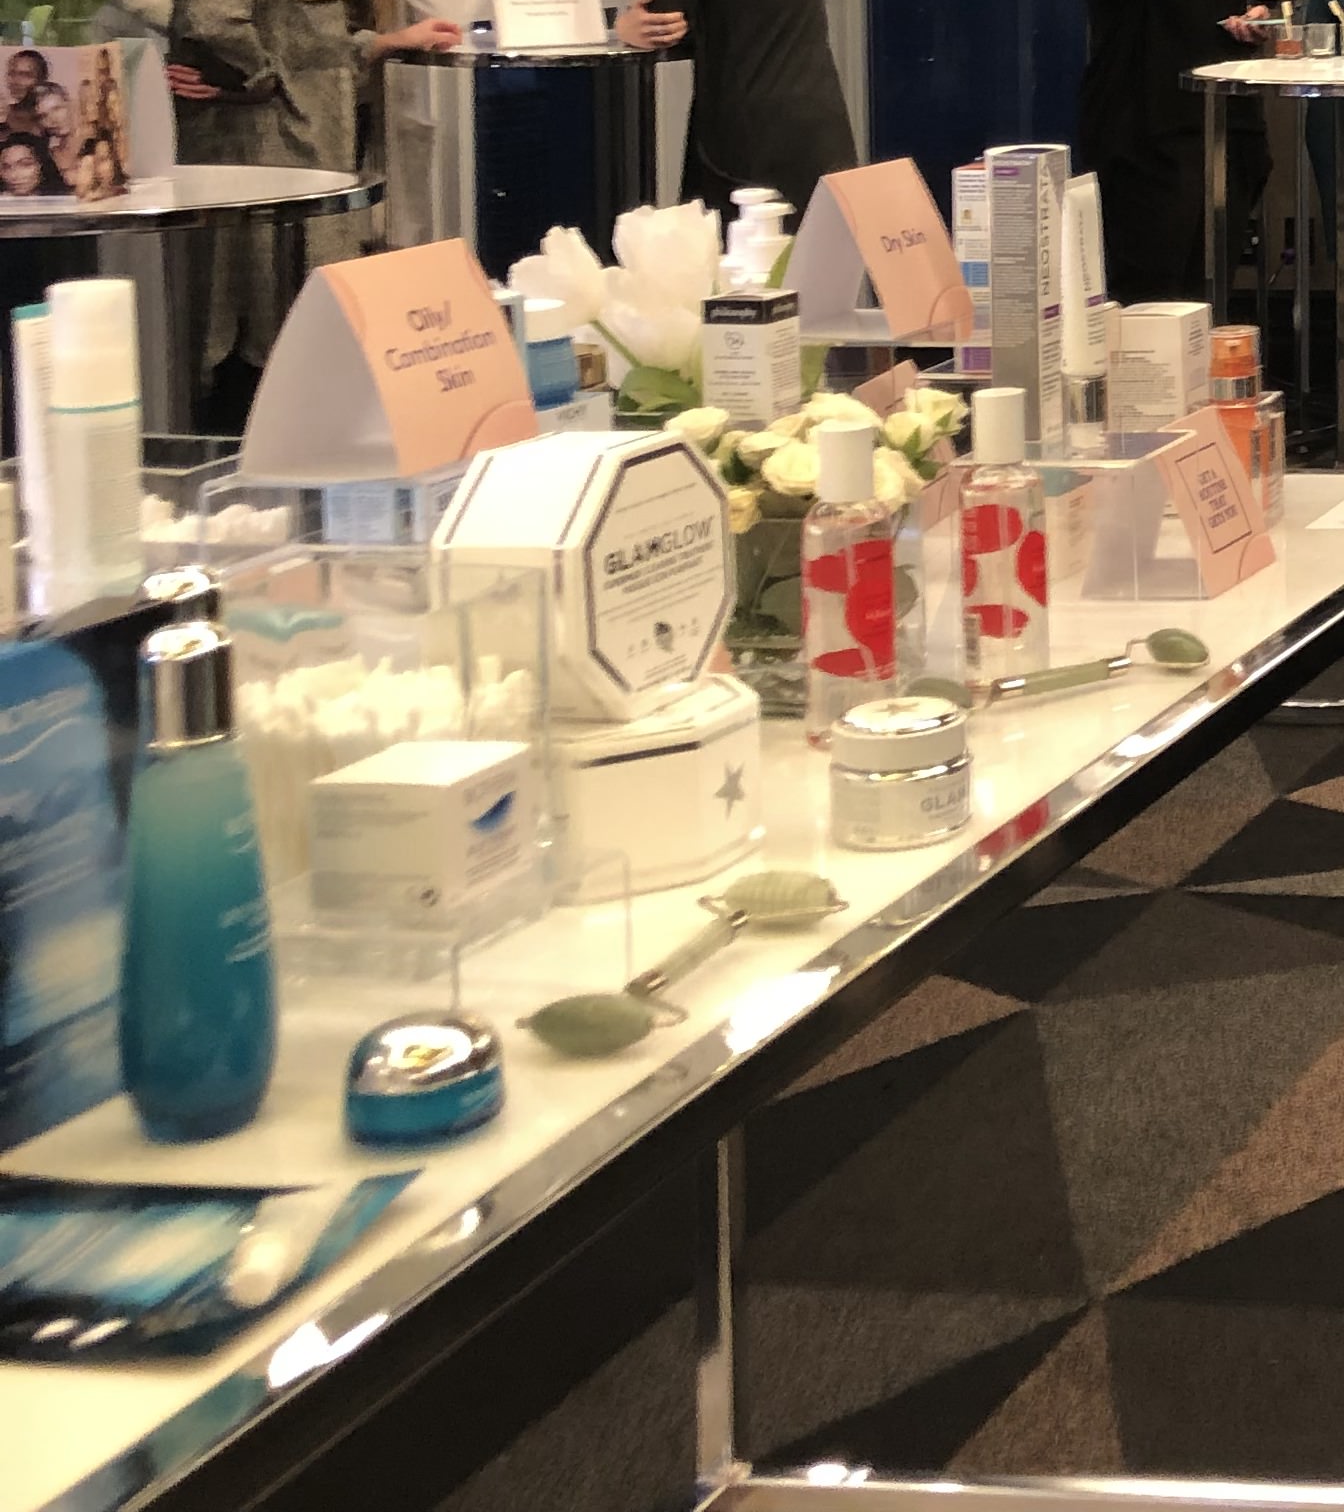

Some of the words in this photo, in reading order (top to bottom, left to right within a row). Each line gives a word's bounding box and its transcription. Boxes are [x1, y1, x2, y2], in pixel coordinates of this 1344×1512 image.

[880, 236, 904, 255] Dry
[901, 228, 928, 248] Skin
[1039, 164, 1051, 297] NEOSTRATA
[407, 301, 451, 332] Oily/
[384, 330, 497, 372] Combination
[435, 365, 477, 393] Skin
